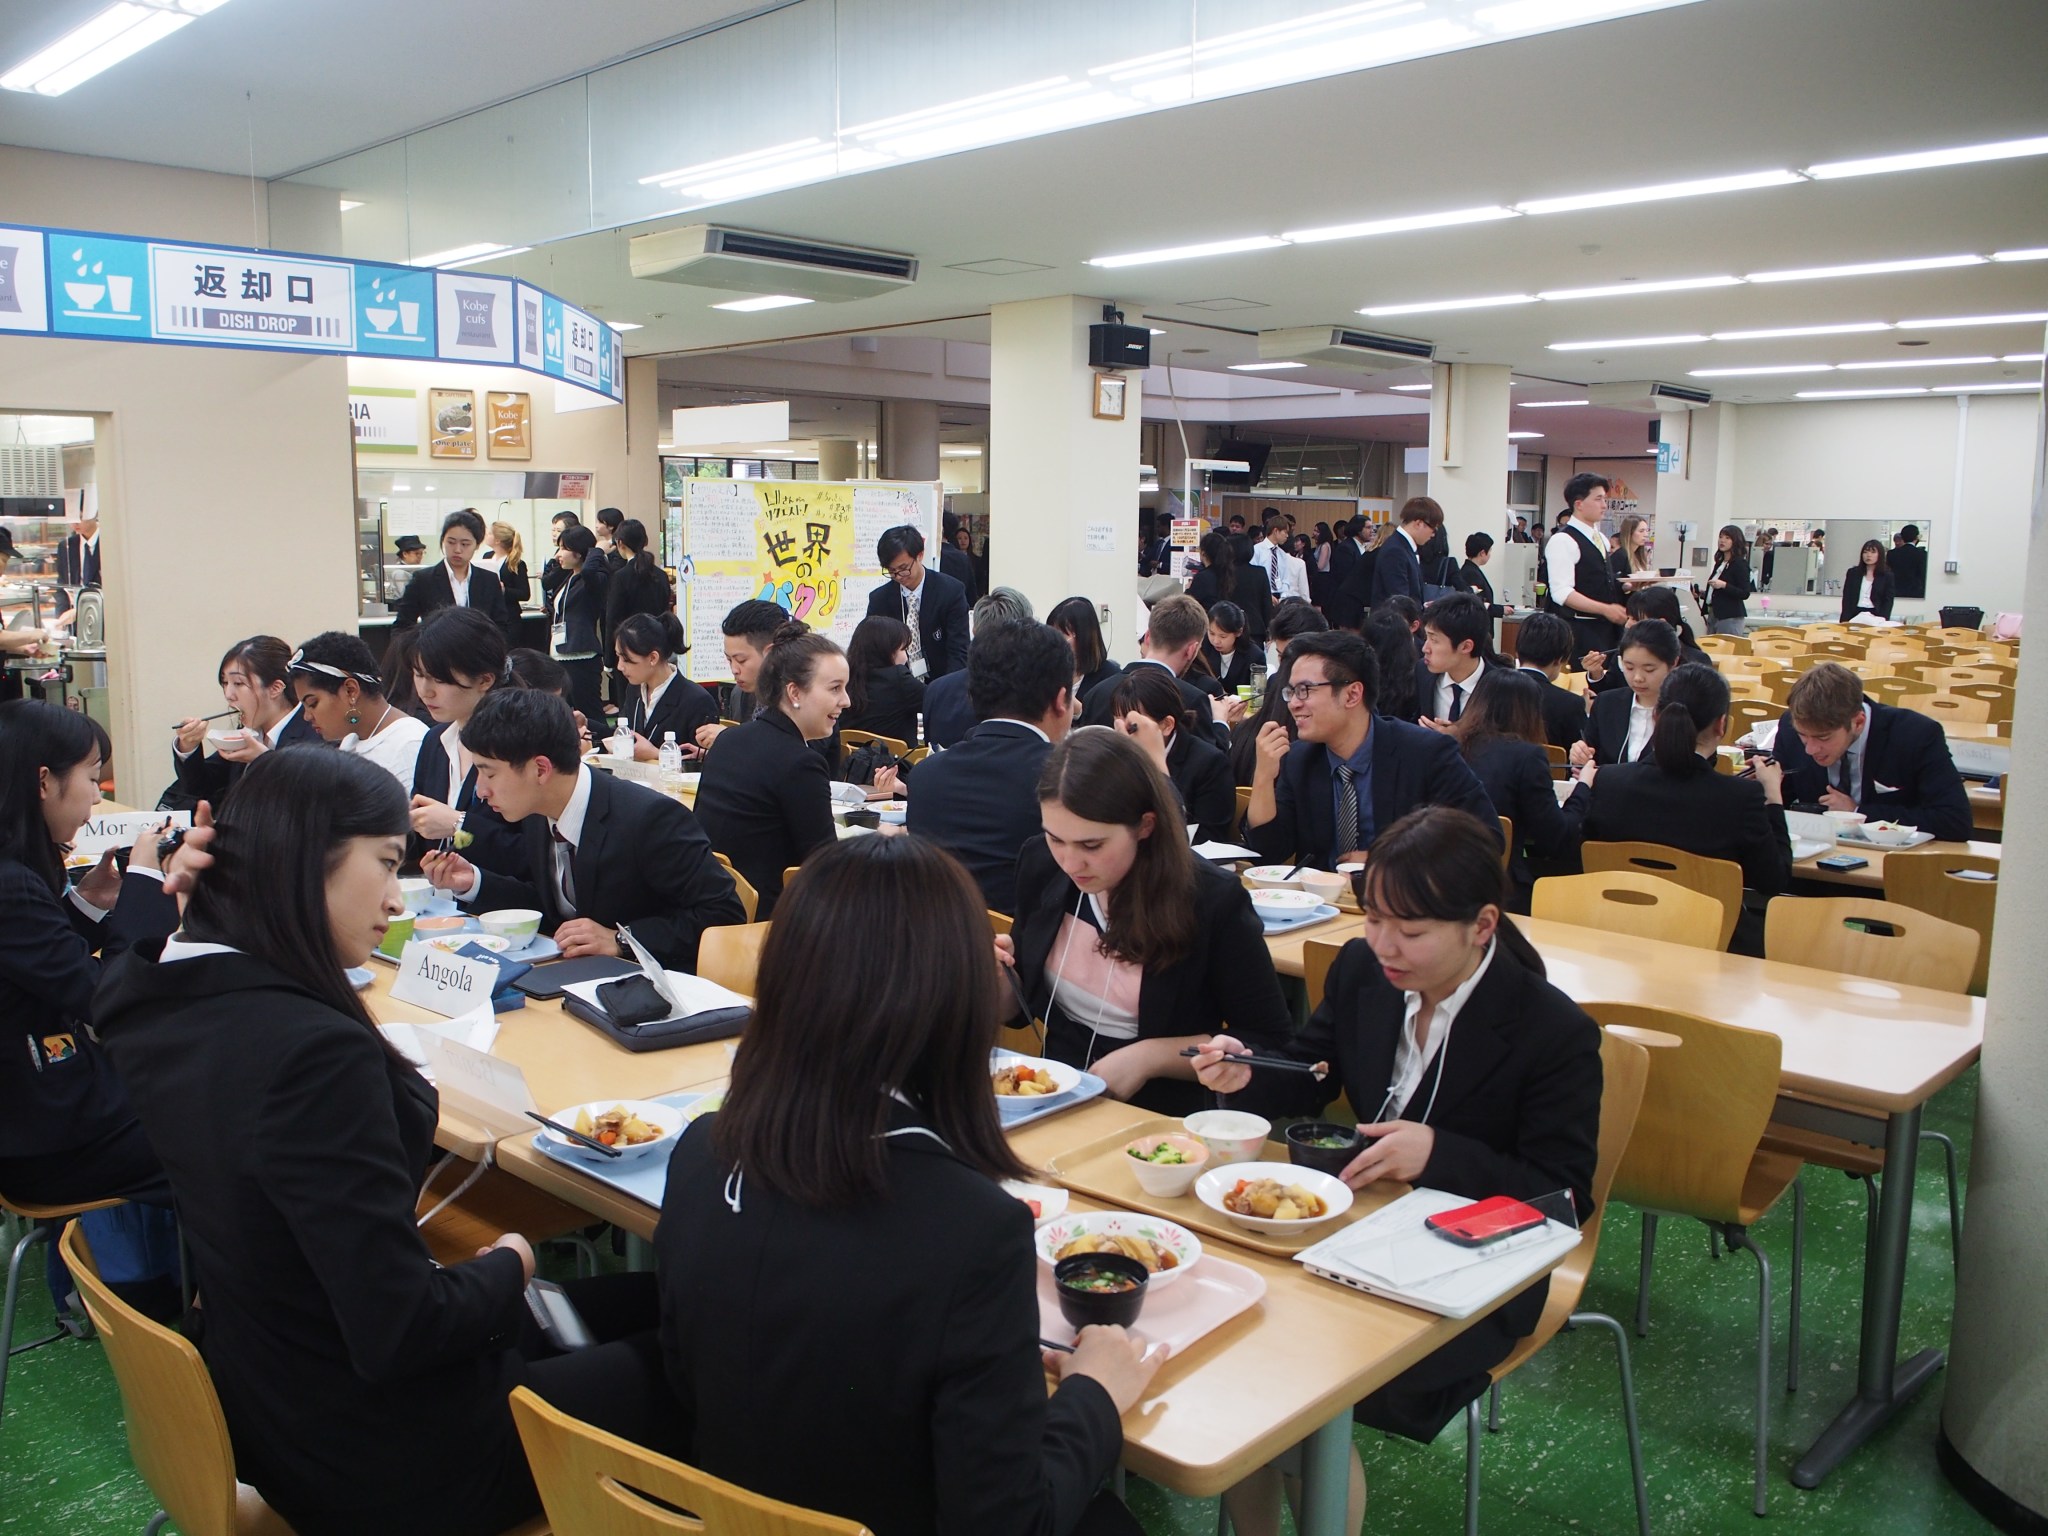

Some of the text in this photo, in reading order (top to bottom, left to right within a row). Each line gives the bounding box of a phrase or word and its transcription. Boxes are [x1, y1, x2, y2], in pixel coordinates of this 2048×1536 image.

[194, 264, 314, 304] 返却口
[463, 299, 489, 312] Kobe
[219, 312, 298, 333] DISH DROP
[497, 410, 519, 419] Kobe
[763, 522, 831, 568] 世界
[796, 562, 813, 579] の
[417, 954, 473, 992] Angola
